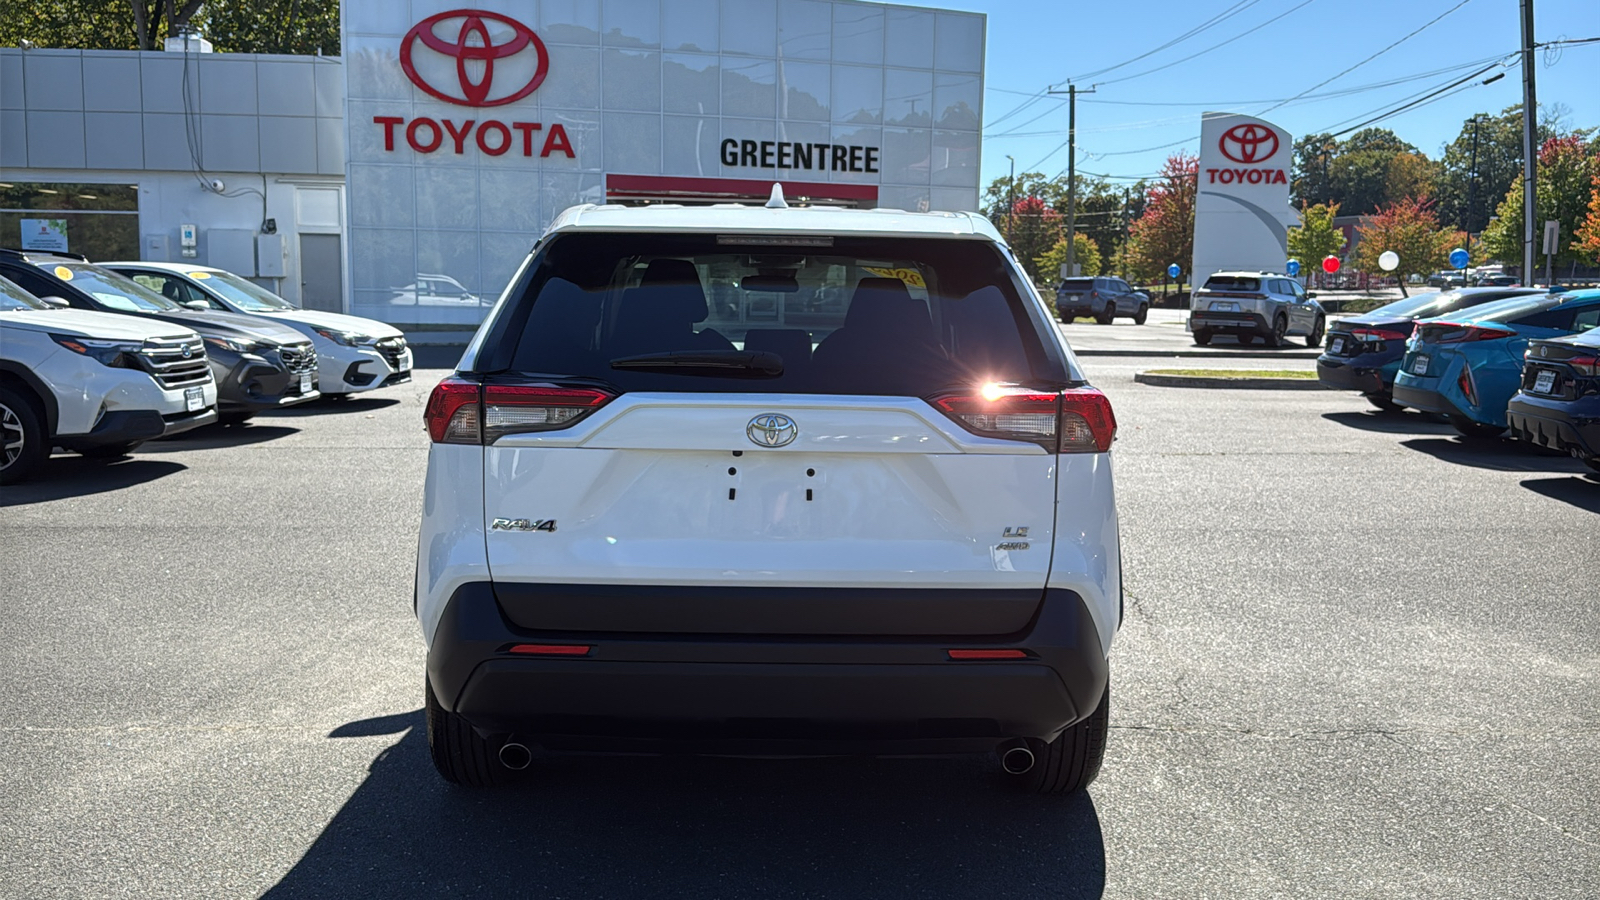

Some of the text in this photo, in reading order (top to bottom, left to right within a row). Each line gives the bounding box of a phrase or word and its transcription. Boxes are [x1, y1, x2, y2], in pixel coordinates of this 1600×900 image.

[373, 116, 576, 158] TOYOTA
[720, 138, 879, 173] GREENTREE
[1206, 168, 1287, 185] TOYOTA
[492, 517, 557, 533] RAV4
[1002, 526, 1029, 538] LE
[996, 541, 1030, 551] AWD
